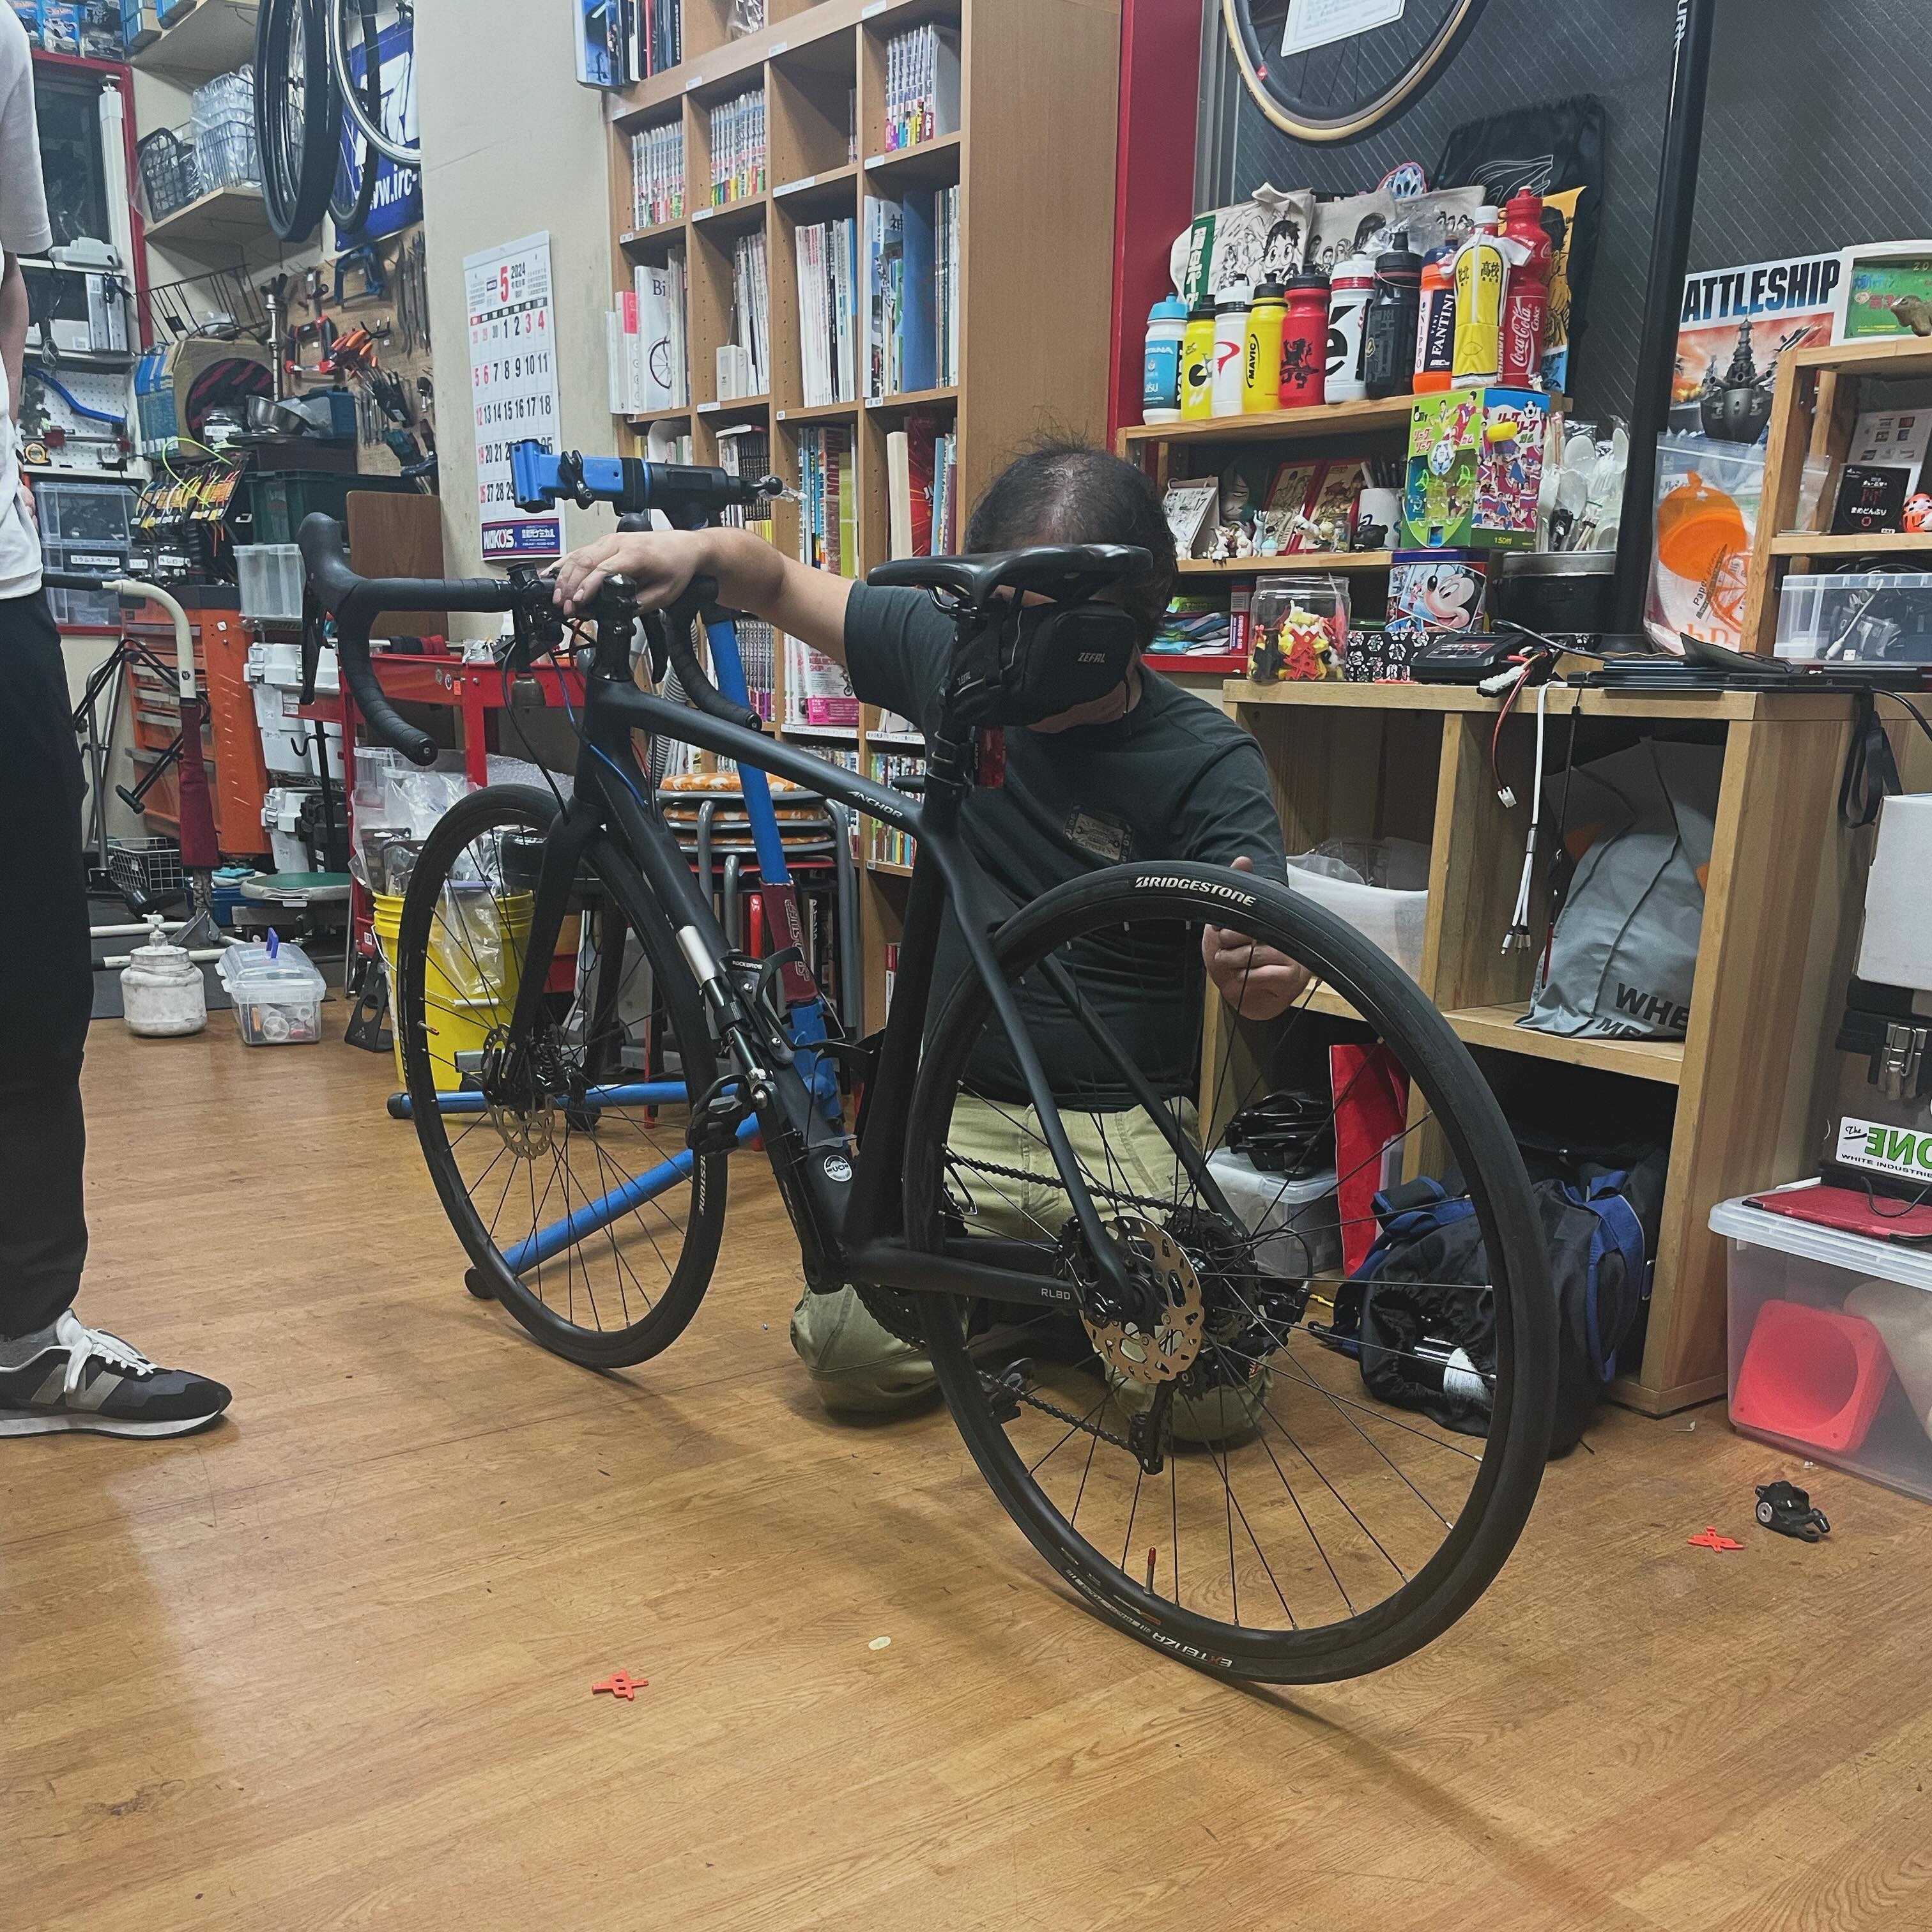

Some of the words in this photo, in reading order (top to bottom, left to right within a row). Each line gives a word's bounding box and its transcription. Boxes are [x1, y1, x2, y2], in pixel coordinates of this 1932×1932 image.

[511, 261, 526, 279] 2024
[500, 265, 509, 303] 5
[1682, 259, 1841, 323] ATTLESHIP
[503, 319, 508, 339] 1
[514, 316, 520, 336] 2
[525, 313, 532, 334] 3
[538, 310, 545, 331] 4
[1431, 294, 1455, 356] FANTINI
[1530, 305, 1541, 332] Coke
[475, 367, 480, 387] 5
[484, 365, 489, 385] 6
[493, 362, 498, 382] 7
[504, 360, 510, 379] 8
[515, 358, 521, 377] 9
[526, 355, 535, 376] 10
[538, 352, 548, 374] 11
[1248, 342, 1257, 379] MAVIC
[476, 406, 482, 425] 12
[484, 404, 491, 424] 13
[493, 402, 502, 422] 14
[503, 401, 512, 420] 15
[515, 399, 524, 418] 16
[526, 397, 536, 417] 17
[539, 395, 551, 415] 18
[494, 443, 502, 462] 21
[487, 484, 494, 502] 27
[496, 482, 504, 502] 28
[1077, 652, 1105, 663] ZEFAL
[847, 791, 903, 818] ANCHOR
[1135, 877, 1257, 907] BRIDGESTONE
[1845, 1126, 1862, 1135] The
[1841, 1153, 1874, 1165] WHITE
[1041, 1287, 1071, 1300] RL8D
